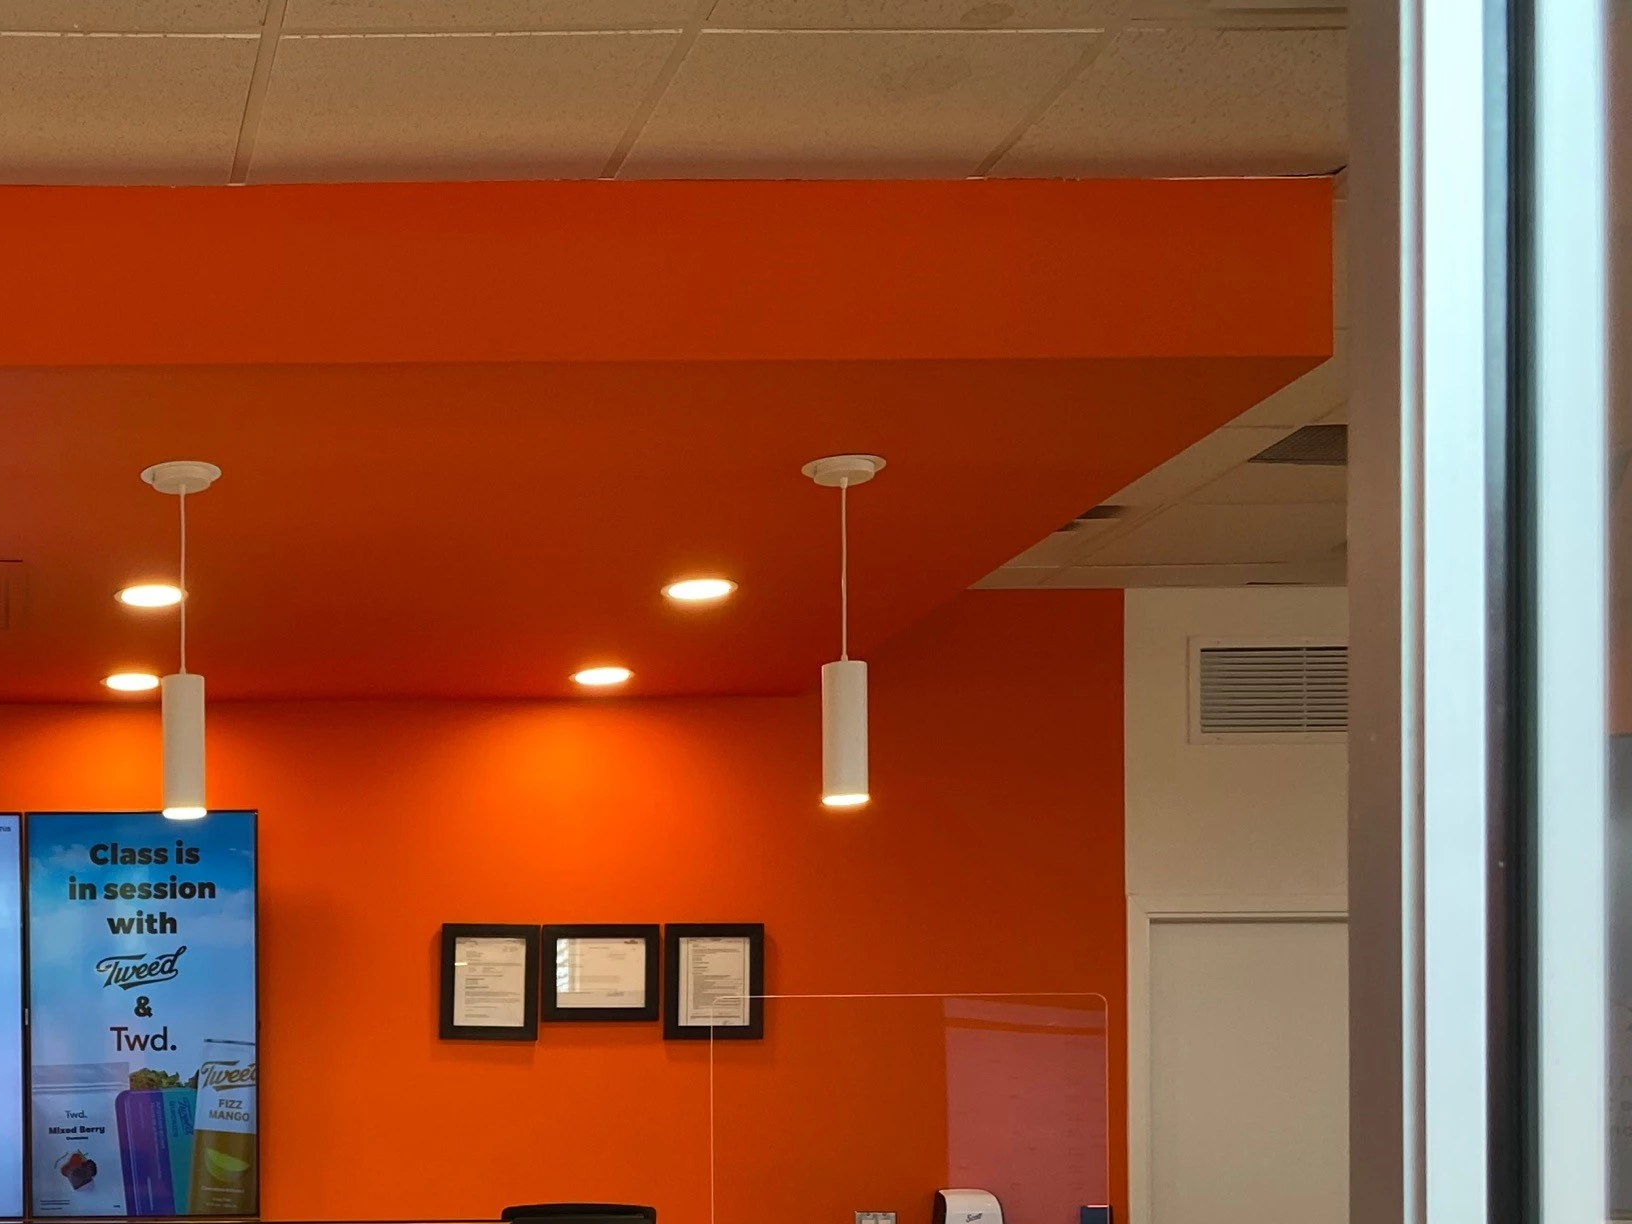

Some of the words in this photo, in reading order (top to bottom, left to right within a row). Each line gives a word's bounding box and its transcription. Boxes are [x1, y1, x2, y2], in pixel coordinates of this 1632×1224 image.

[89, 843, 168, 866] Class
[175, 840, 200, 864] is
[69, 875, 96, 900] in
[103, 875, 216, 899] session
[106, 910, 177, 934] with
[96, 946, 187, 991] Tweed
[134, 996, 153, 1018] &
[110, 1026, 177, 1051] Twd.
[209, 1110, 250, 1121] MANGO
[218, 1098, 243, 1109] FIZZ
[48, 1126, 77, 1134] Mixed
[79, 1125, 106, 1134] Berry
